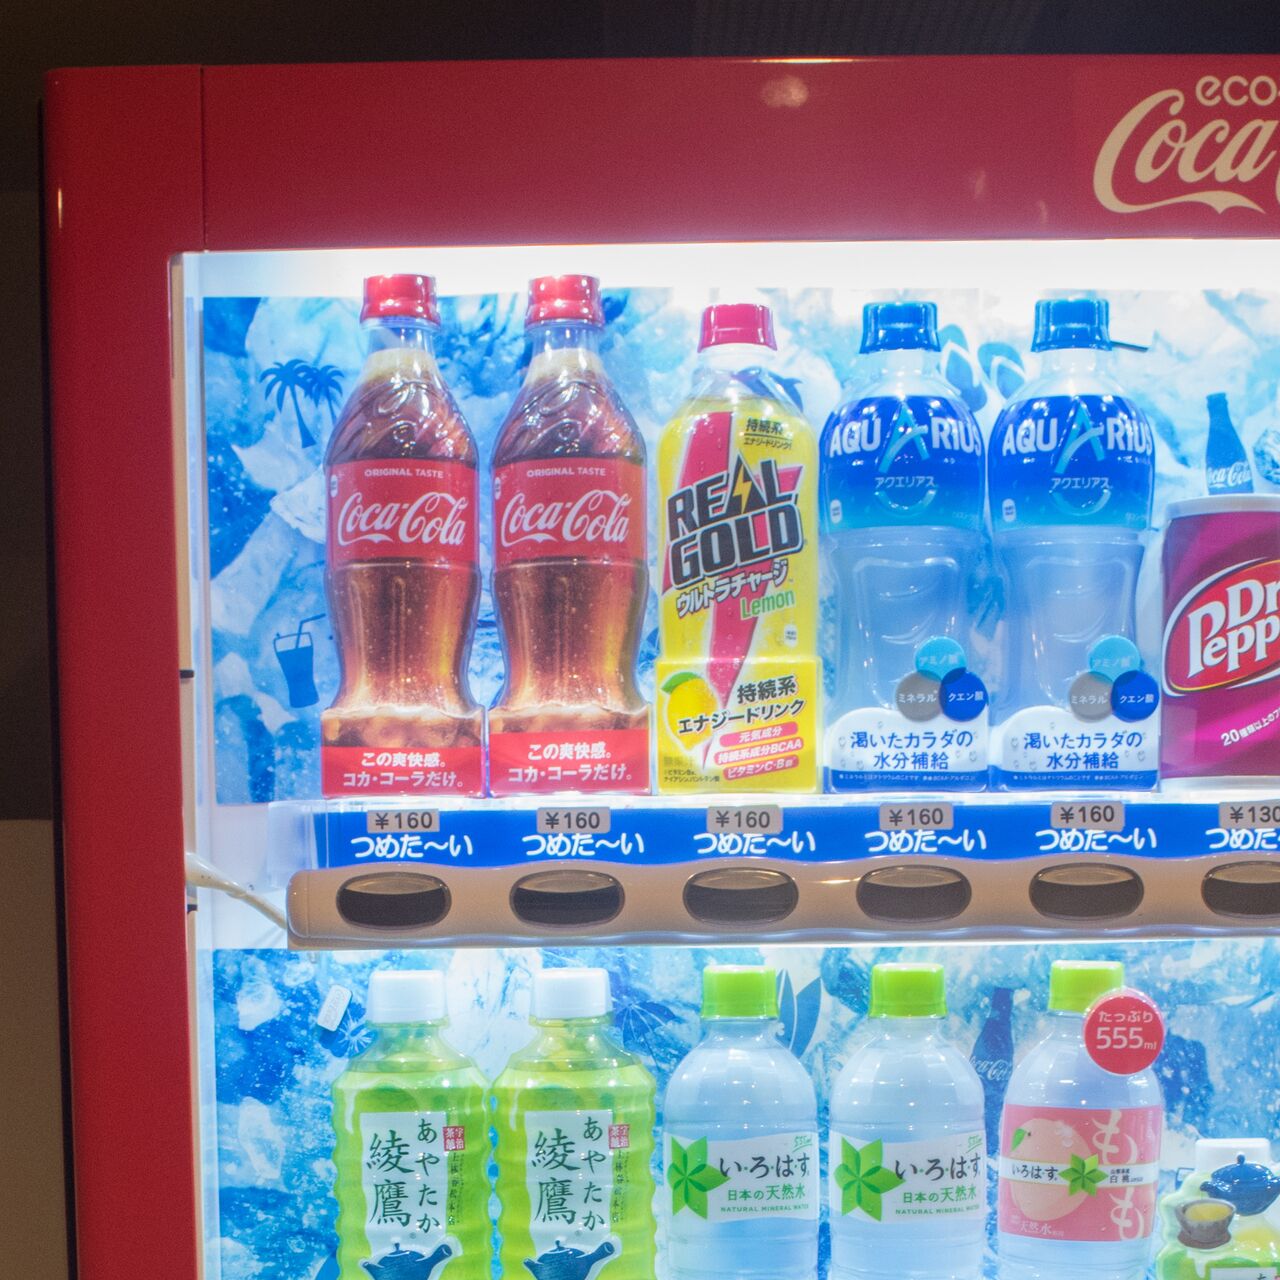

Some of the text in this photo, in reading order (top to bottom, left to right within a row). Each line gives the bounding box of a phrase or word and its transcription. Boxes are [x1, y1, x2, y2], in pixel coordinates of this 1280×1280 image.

[829, 403, 984, 473] AQUARIUS
[365, 467, 444, 478] ORIGINAL TASTE
[875, 475, 936, 489] アクエリアス
[1050, 476, 1112, 490] アクエリアス
[668, 454, 797, 542] REAL
[338, 490, 468, 545] Coca-Cola
[501, 489, 633, 546] Coca-Cola
[671, 503, 803, 589] GOLD
[676, 560, 789, 617] ウルトラチャージ
[740, 590, 795, 620] Lemon
[737, 675, 797, 704] 持続系
[678, 699, 806, 734] エナジードリンク
[851, 730, 973, 749] 渇いたカラダの
[362, 752, 447, 768] この爽快感。
[528, 742, 613, 760] この爽快感。
[873, 751, 949, 770] 水分補給
[1046, 753, 1119, 770] 水分補給
[343, 770, 464, 787] コカ・コーラだけ。
[374, 811, 432, 830] ¥160
[545, 811, 601, 830] ¥160
[888, 807, 944, 826] ¥160
[1060, 805, 1115, 824] ¥160
[1098, 1010, 1153, 1024] たっぷり
[1096, 1026, 1157, 1051] 555ml
[366, 1129, 414, 1226] 綾鷹
[415, 1117, 440, 1233] あやたか
[531, 1128, 577, 1225] 綾鷹
[583, 1115, 606, 1232] あやたか
[727, 1183, 806, 1202] 日本の天然水
[903, 1185, 977, 1204] 日本の天然水
